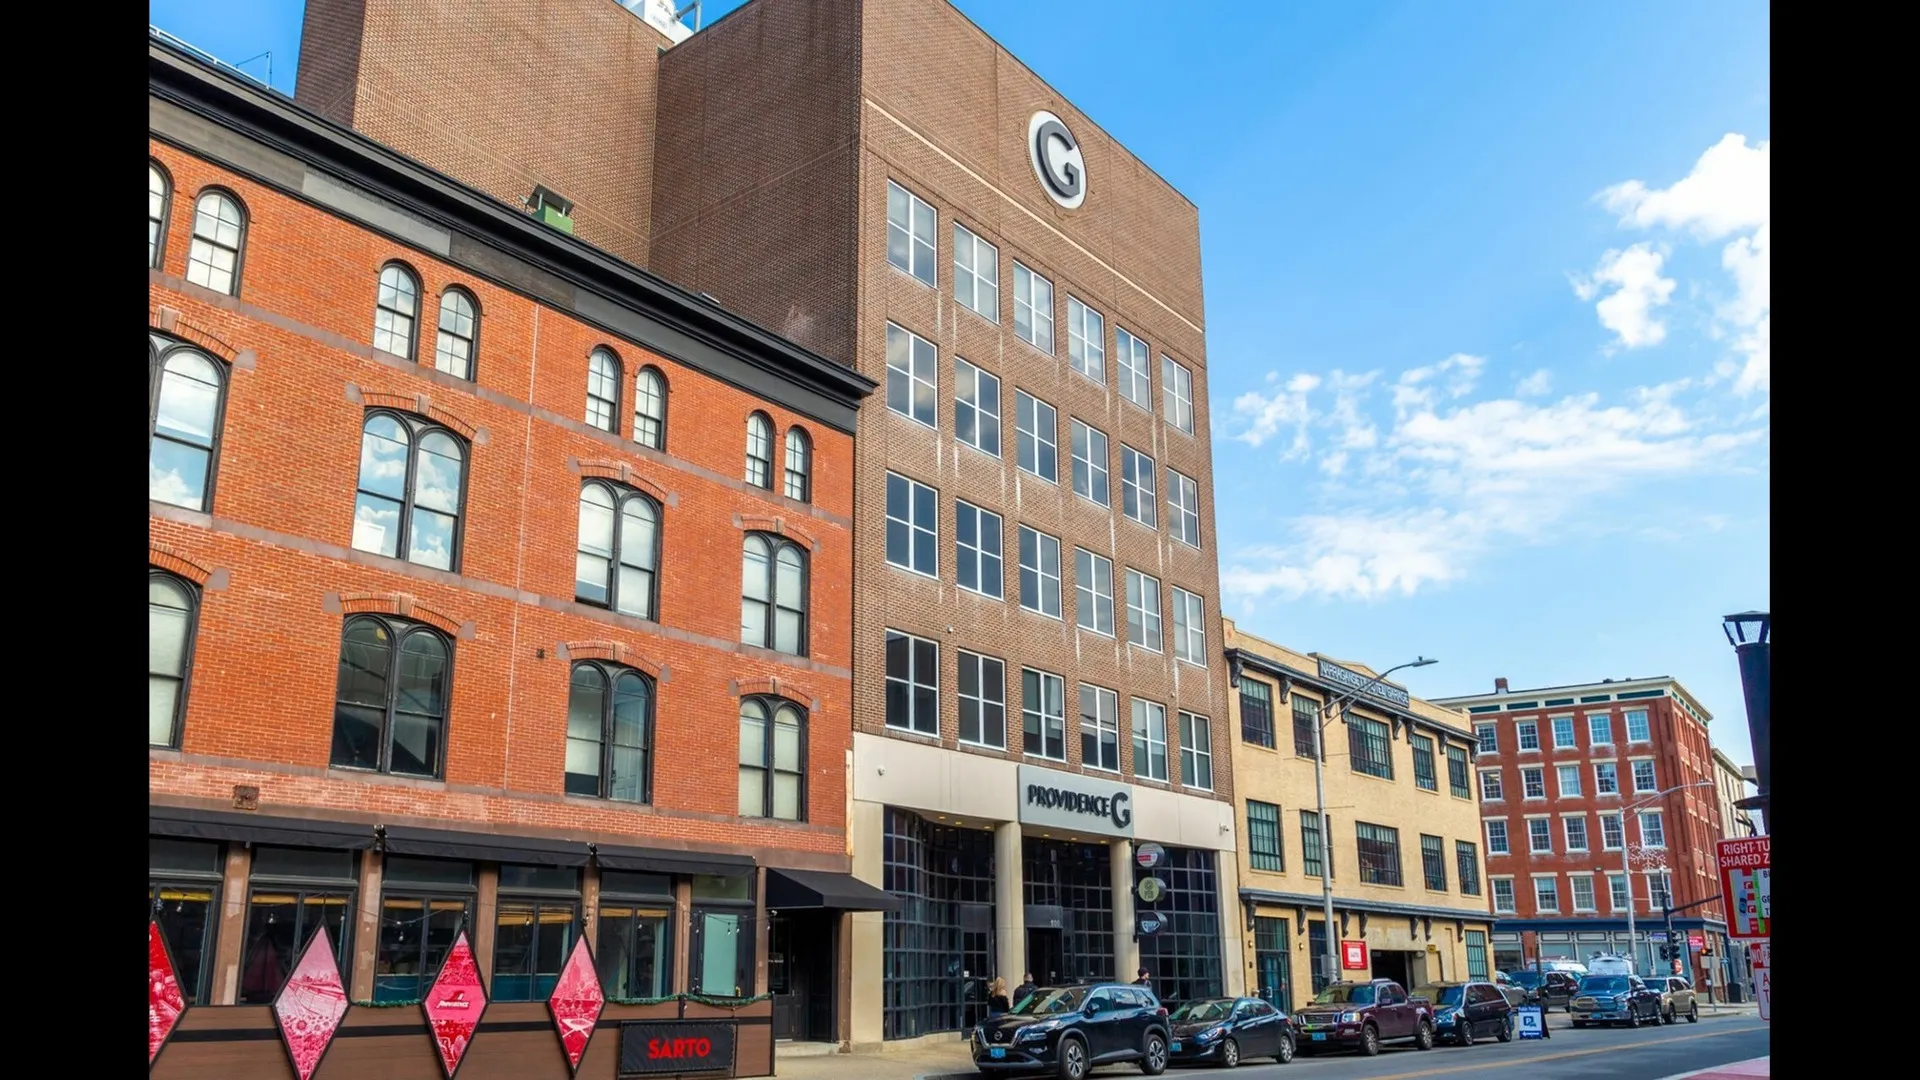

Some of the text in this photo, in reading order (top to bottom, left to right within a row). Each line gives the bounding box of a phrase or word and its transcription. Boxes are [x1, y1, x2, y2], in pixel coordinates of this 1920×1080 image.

[1036, 120, 1080, 198] G
[1028, 784, 1130, 828] PROVIDENCE G
[1720, 853, 1761, 867] SHARED
[648, 1037, 711, 1059] SARTO
